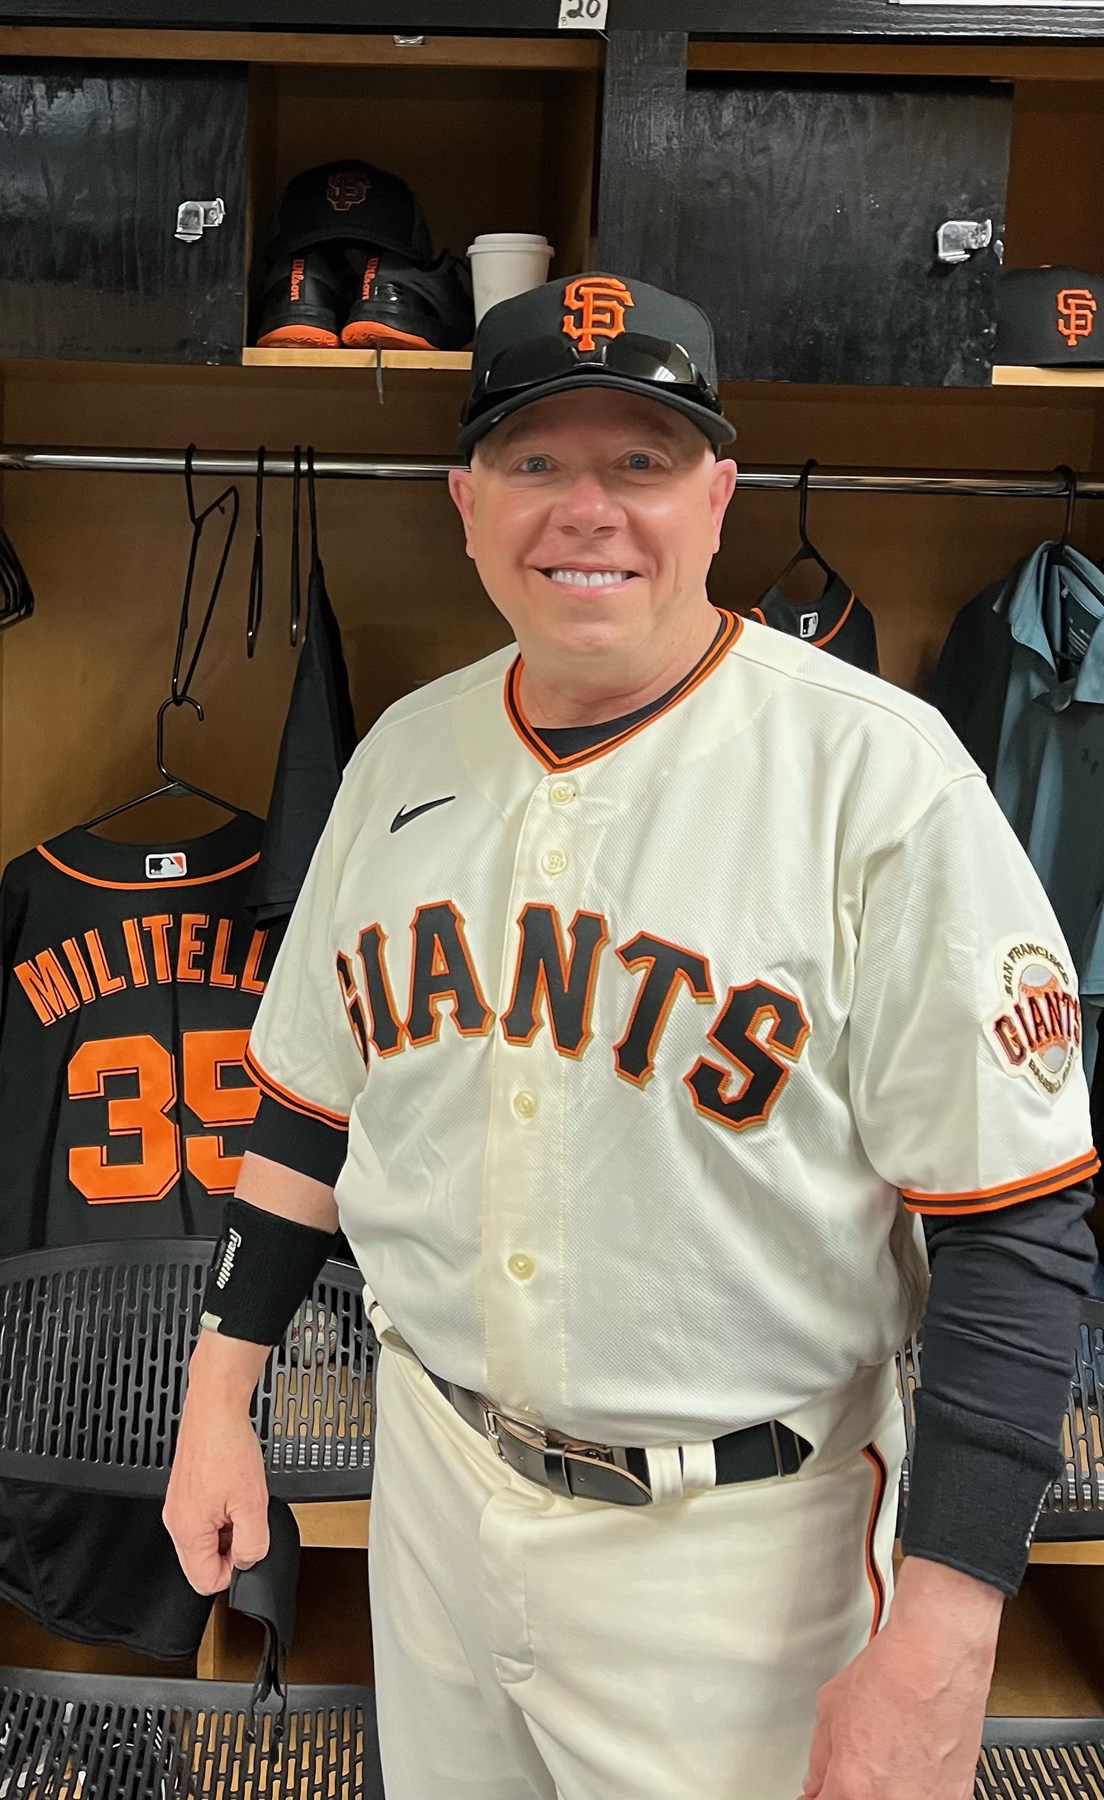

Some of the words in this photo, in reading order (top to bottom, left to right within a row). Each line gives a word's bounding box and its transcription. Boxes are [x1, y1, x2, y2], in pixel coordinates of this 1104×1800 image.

[566, 0, 601, 18] 20
[290, 258, 305, 301] Wilson
[362, 257, 379, 301] Wilson
[563, 276, 635, 351] SF
[1056, 289, 1097, 346] SF
[68, 1029, 263, 1204] 35
